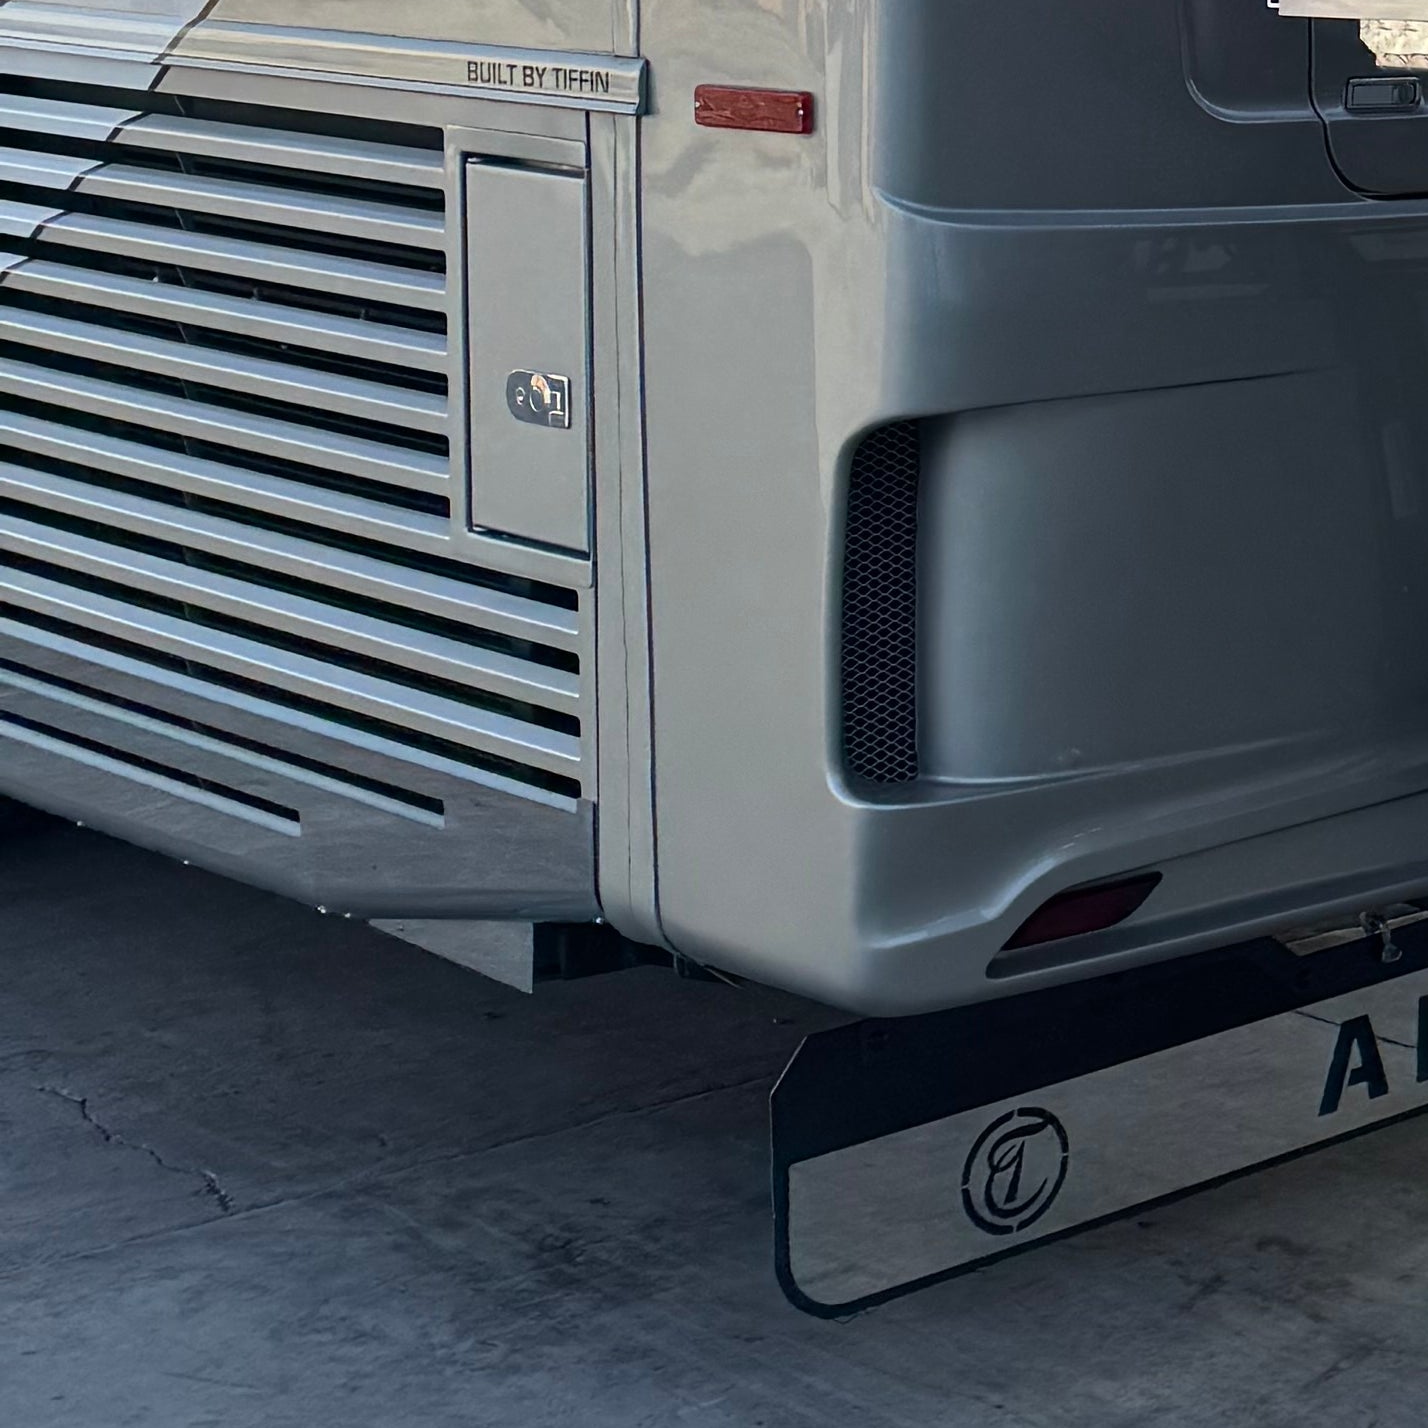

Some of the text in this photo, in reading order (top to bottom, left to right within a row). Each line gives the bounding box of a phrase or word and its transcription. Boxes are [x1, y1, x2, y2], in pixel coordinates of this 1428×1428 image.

[467, 60, 611, 94] BUILT BY TIFFIN
